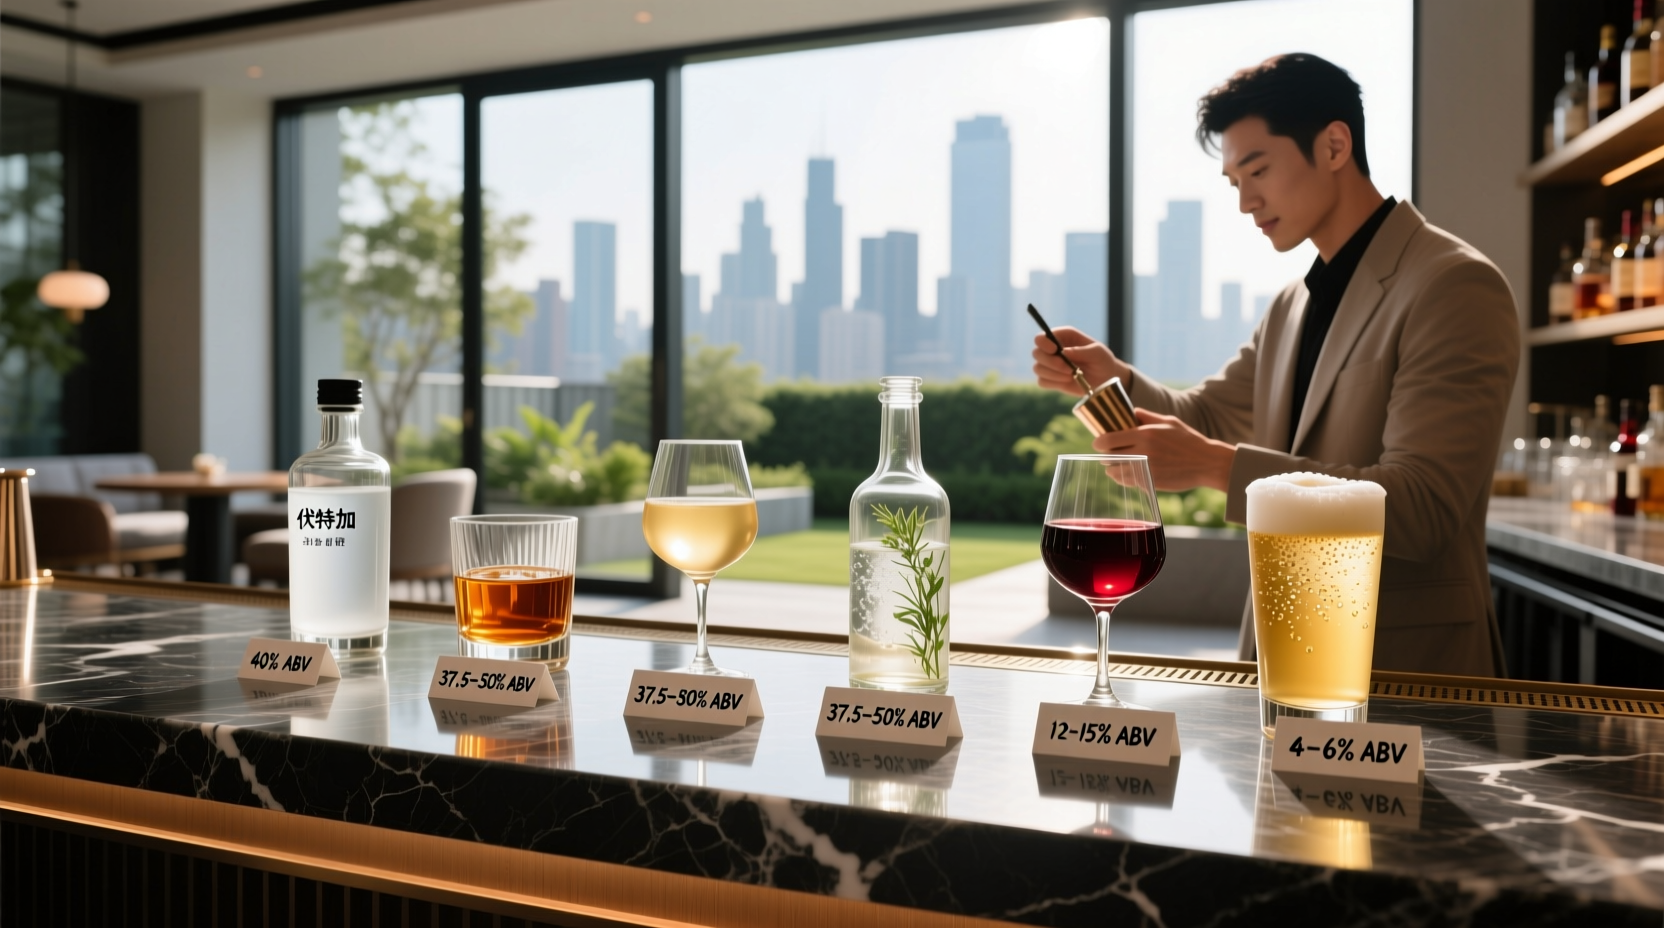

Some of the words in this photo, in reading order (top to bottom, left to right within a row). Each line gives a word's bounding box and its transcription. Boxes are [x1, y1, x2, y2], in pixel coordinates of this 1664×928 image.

[297, 508, 355, 530] 伏特加
[250, 651, 279, 671] 40%
[282, 654, 313, 673] ABV
[438, 669, 505, 691] 37.5-50%
[506, 673, 536, 693] ABV
[709, 691, 744, 711] ABV
[826, 703, 904, 728] 37.5-50%
[906, 710, 943, 730] ABV
[1050, 720, 1112, 744] 12-15%
[1115, 725, 1157, 747] ABV
[1288, 736, 1355, 762] 4-6%
[1359, 740, 1408, 764] ABV
